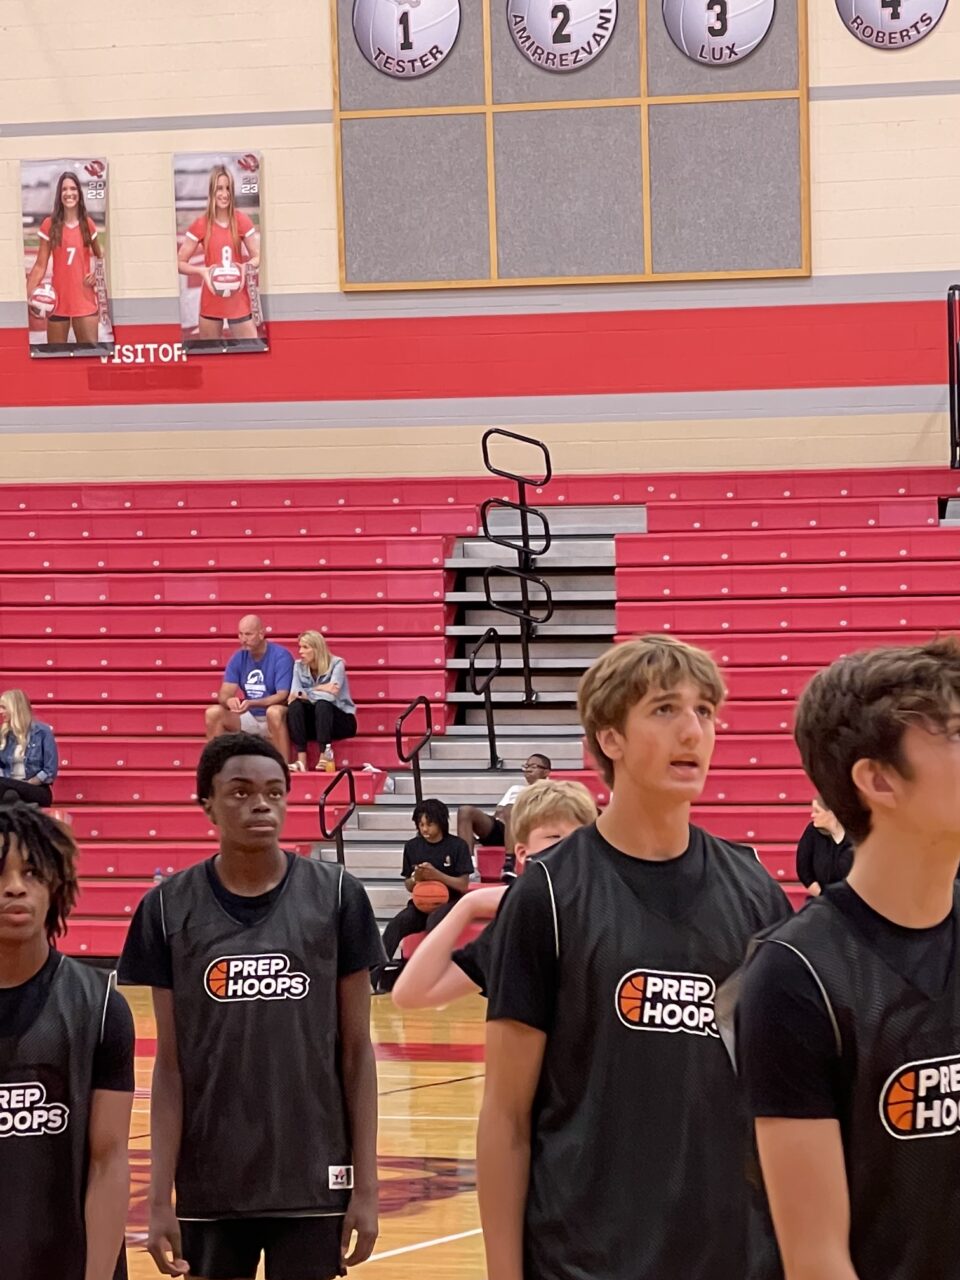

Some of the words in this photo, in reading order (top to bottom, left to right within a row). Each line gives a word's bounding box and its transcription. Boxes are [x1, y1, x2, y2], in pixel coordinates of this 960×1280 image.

[399, 11, 413, 50] 1
[551, 4, 571, 44] 2
[707, 0, 728, 37] 3
[851, 12, 933, 45] ROBERTS
[512, 8, 613, 67] AMIRREZVANI
[699, 42, 739, 60] LUX
[374, 44, 444, 73] TESTER
[88, 190, 104, 199] 23
[241, 184, 258, 193] 23
[66, 247, 76, 265] 7
[229, 959, 285, 977] PREP
[227, 977, 304, 996] HOOPS
[646, 976, 710, 1002] PREP
[643, 1001, 718, 1031] HOOP
